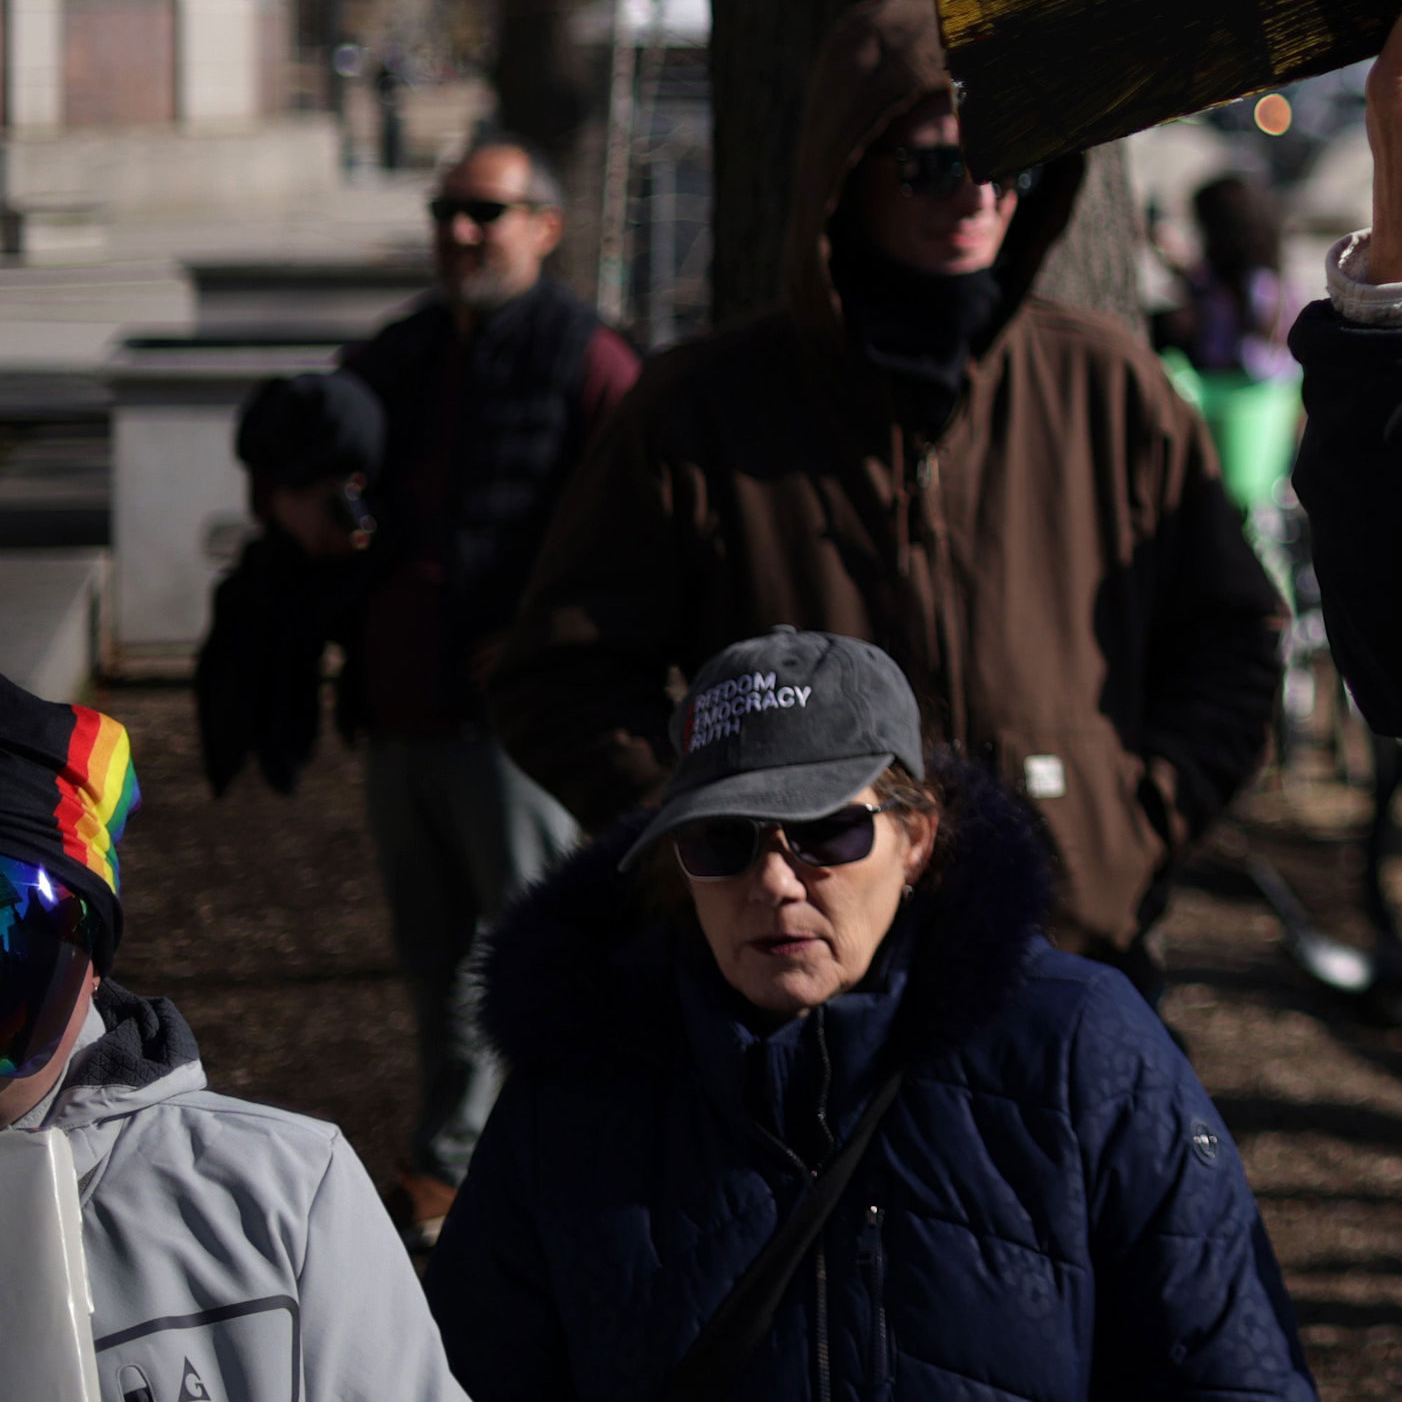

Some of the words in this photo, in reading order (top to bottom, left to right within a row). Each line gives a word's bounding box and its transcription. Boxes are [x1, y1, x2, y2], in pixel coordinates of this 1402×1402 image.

[684, 686, 812, 733] EMOCRACY
[688, 670, 777, 713] REEDOM
[682, 718, 740, 755] RUTH
